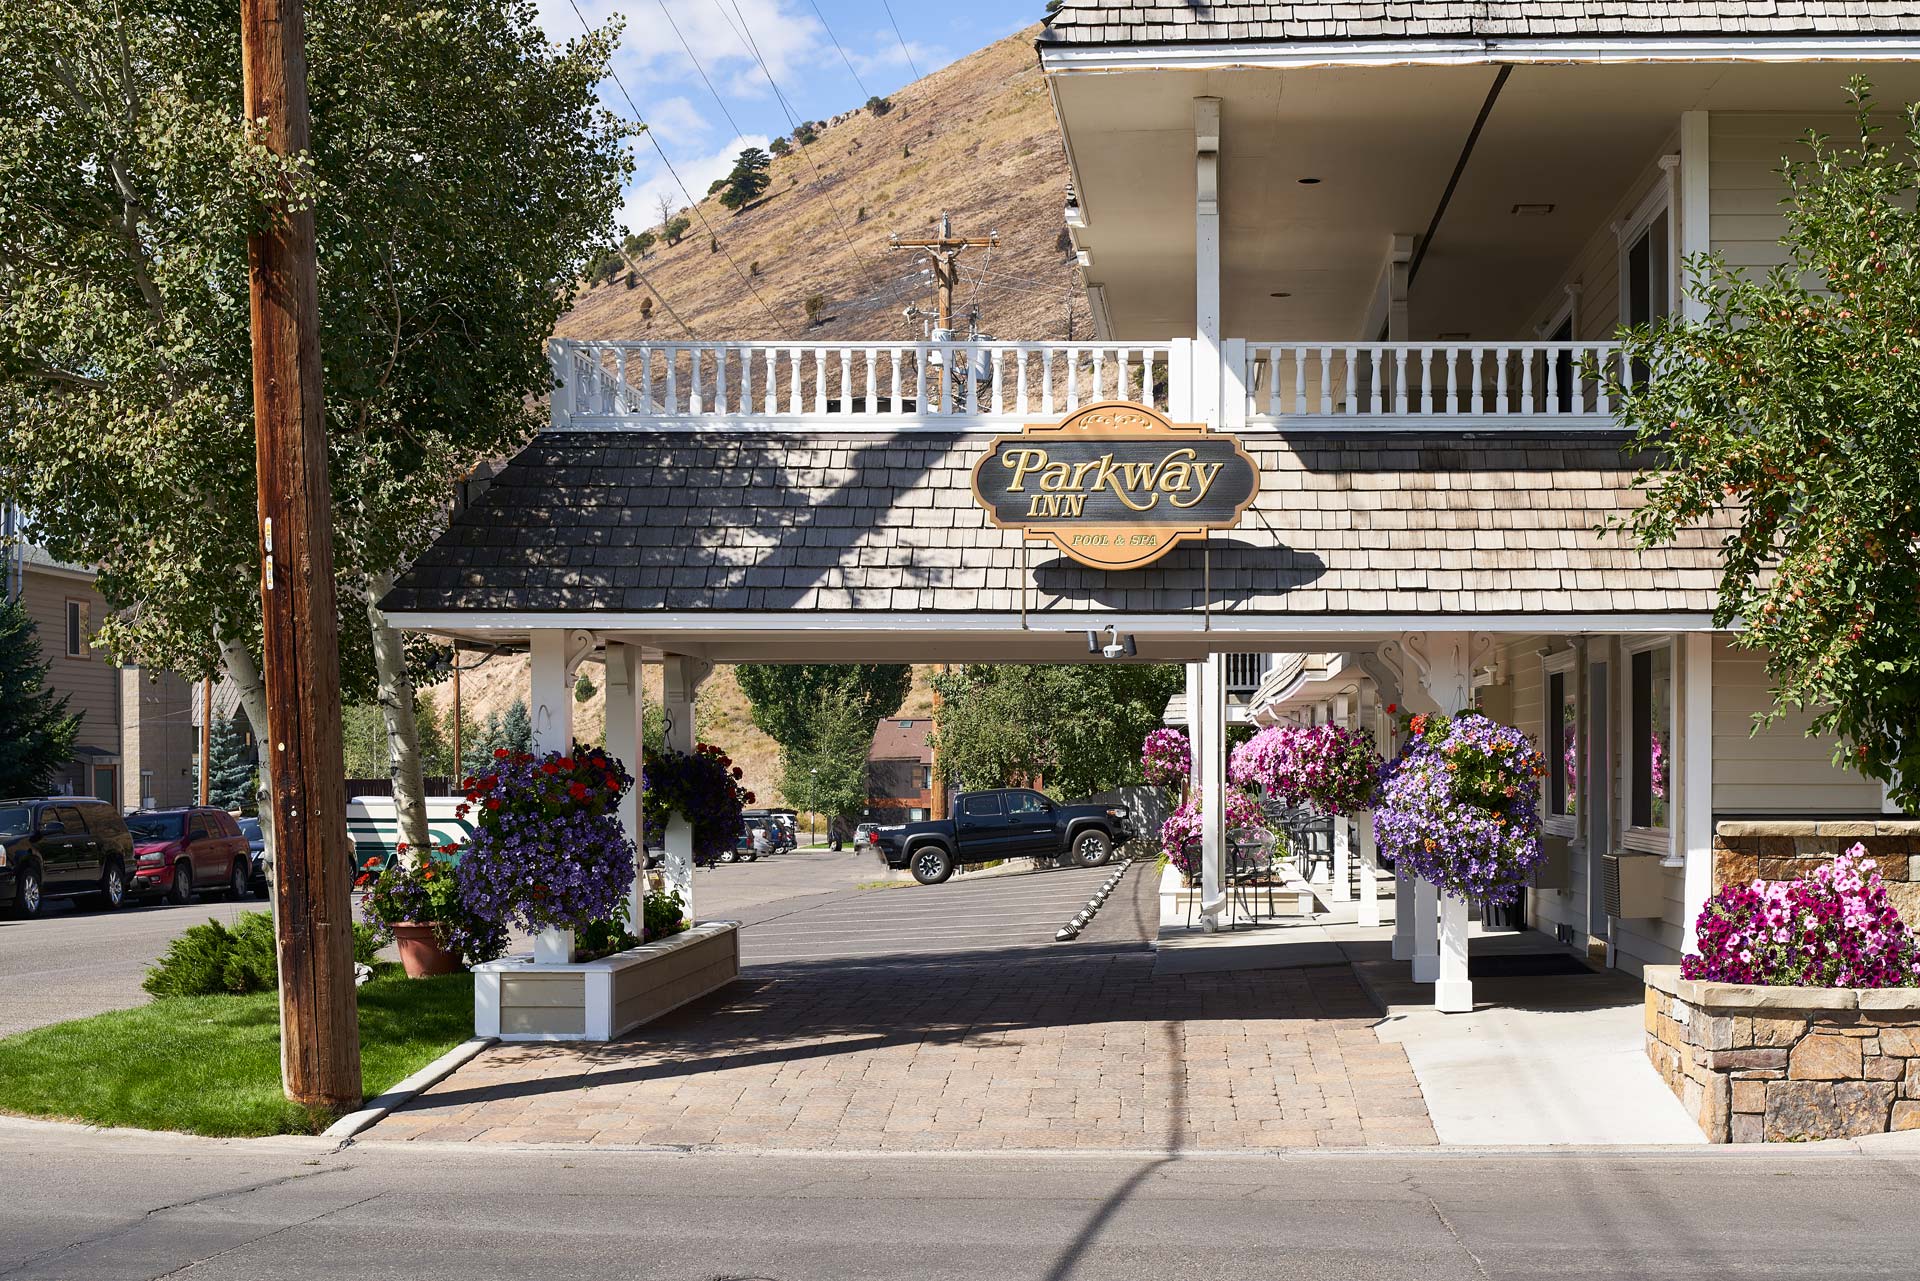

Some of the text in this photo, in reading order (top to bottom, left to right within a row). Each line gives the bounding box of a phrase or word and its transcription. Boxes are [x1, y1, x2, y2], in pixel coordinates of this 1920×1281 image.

[1002, 448, 1224, 511] Parkway
[1026, 494, 1088, 517] INN
[1072, 534, 1158, 547] POOL & SPA
